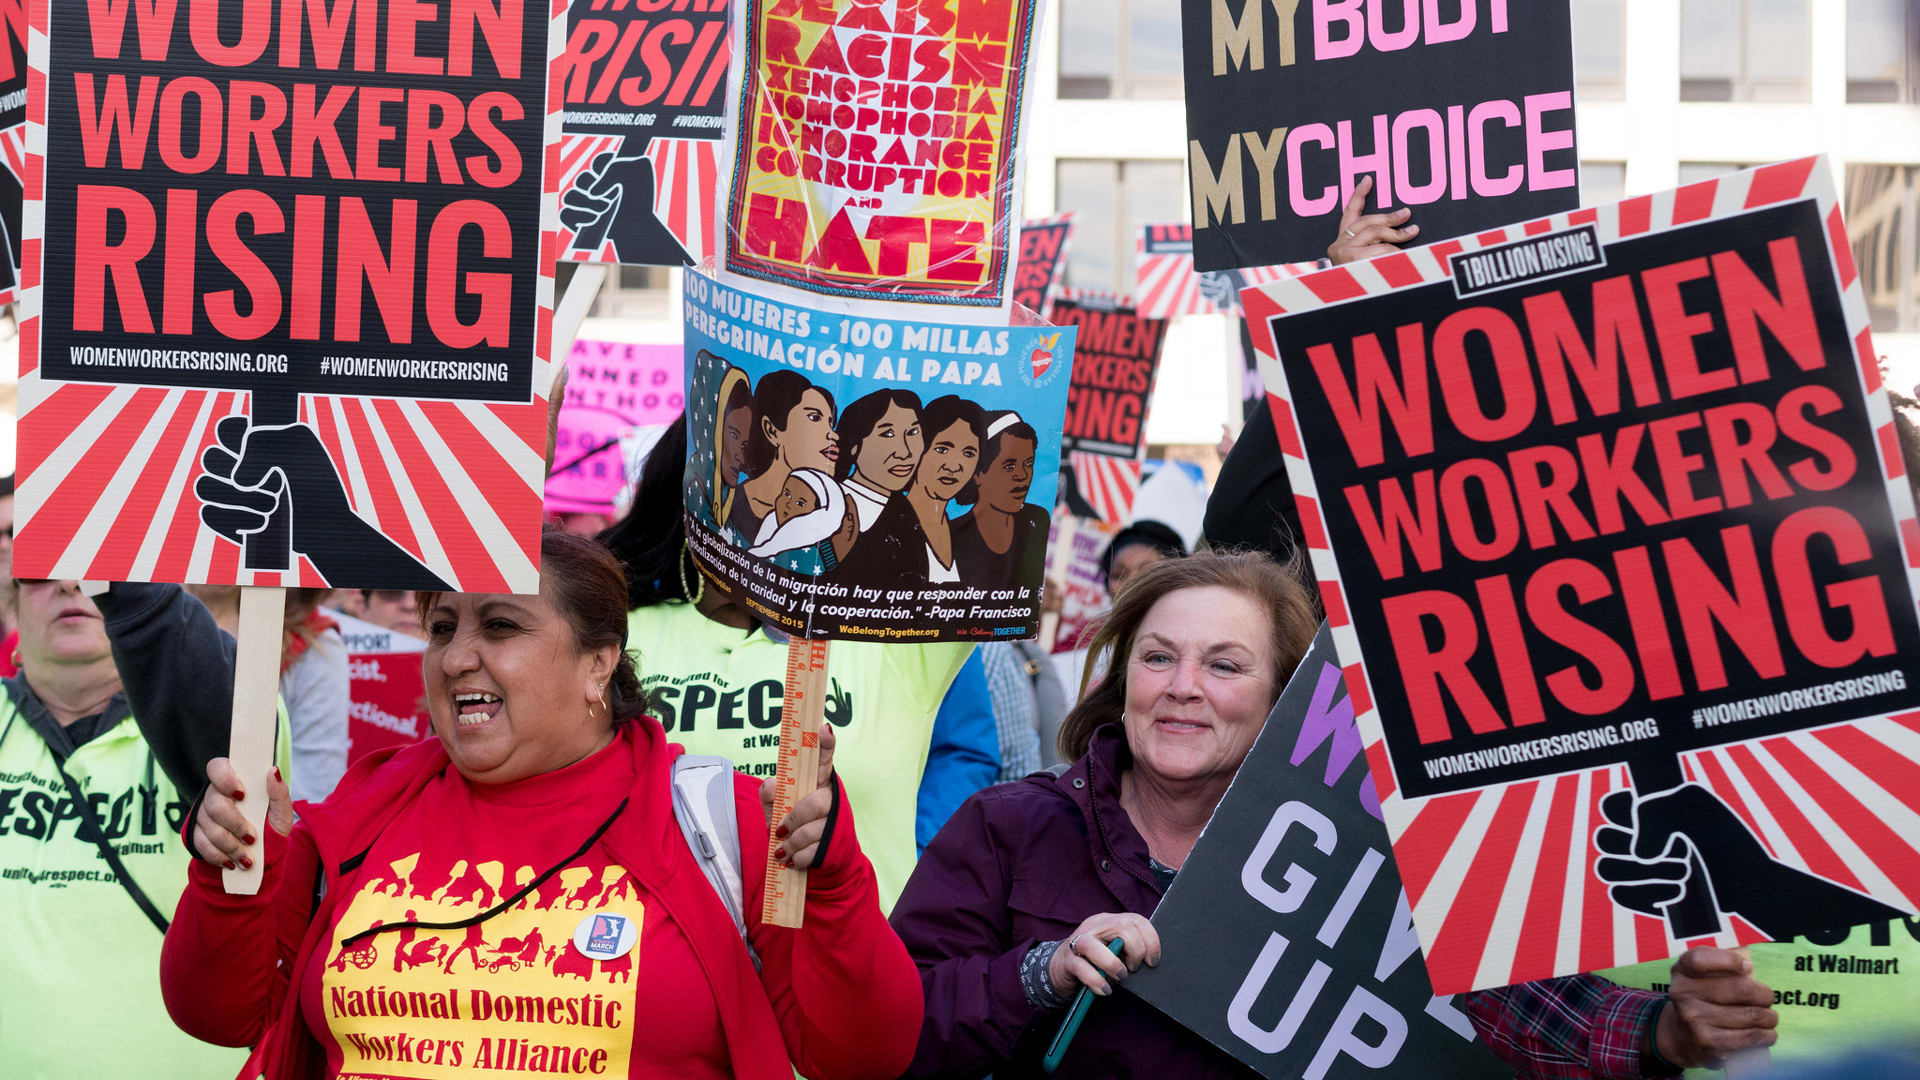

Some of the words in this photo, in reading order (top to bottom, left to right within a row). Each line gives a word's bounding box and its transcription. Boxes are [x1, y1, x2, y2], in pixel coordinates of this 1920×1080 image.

[86, 0, 522, 79] WOMEN
[766, 18, 1008, 89] RACISM
[762, 90, 995, 142] HOMOPHOBIA
[765, 62, 998, 116] XENOPHOBIA
[74, 72, 525, 188] WORKERS
[757, 114, 993, 172] IGNORANCE
[756, 145, 992, 201] CORRUPTION
[745, 192, 986, 283] HATE
[73, 184, 514, 349] RISING
[685, 271, 708, 303] 100
[712, 286, 810, 337] MUJERES
[840, 320, 893, 349] 100
[902, 326, 1010, 356] MILLAS
[70, 346, 288, 374] WOMENWORKERSRISING.ORG
[320, 356, 508, 383] #WOMENWORKERSRISING
[685, 300, 864, 378] PEREGRINACIÓN
[873, 356, 911, 381] AL
[921, 359, 1002, 386] PAPA
[1305, 236, 1828, 469] WOMEN
[1344, 385, 1858, 581] WORKERS
[729, 567, 739, 582] de
[741, 573, 748, 587] la
[750, 582, 787, 606] caridad
[787, 600, 798, 612] y
[801, 599, 815, 613] la
[969, 605, 1031, 619] Francisco
[753, 562, 764, 577] de
[766, 567, 777, 583] la
[778, 576, 848, 598] migración
[853, 585, 882, 603] hay
[886, 590, 914, 603] que
[918, 587, 987, 603] responder
[991, 589, 1014, 600] con
[1018, 586, 1030, 599] la
[781, 616, 804, 629] 2015
[839, 625, 940, 639] WeBelongTogether.org
[1382, 506, 1897, 745] RISING
[713, 673, 730, 688] for
[1691, 670, 1906, 729] #WOMENWORKERSRISING
[743, 736, 756, 748] at
[1423, 718, 1659, 779] WOMENWORKERSRISING.ORG
[1795, 955, 1813, 971] at
[1818, 954, 1899, 974] Walmart
[332, 985, 461, 1019] National
[471, 989, 622, 1029] Domestic
[1227, 930, 1409, 1080] UP
[345, 1033, 463, 1068] Workers
[473, 1037, 608, 1074] Alliance
